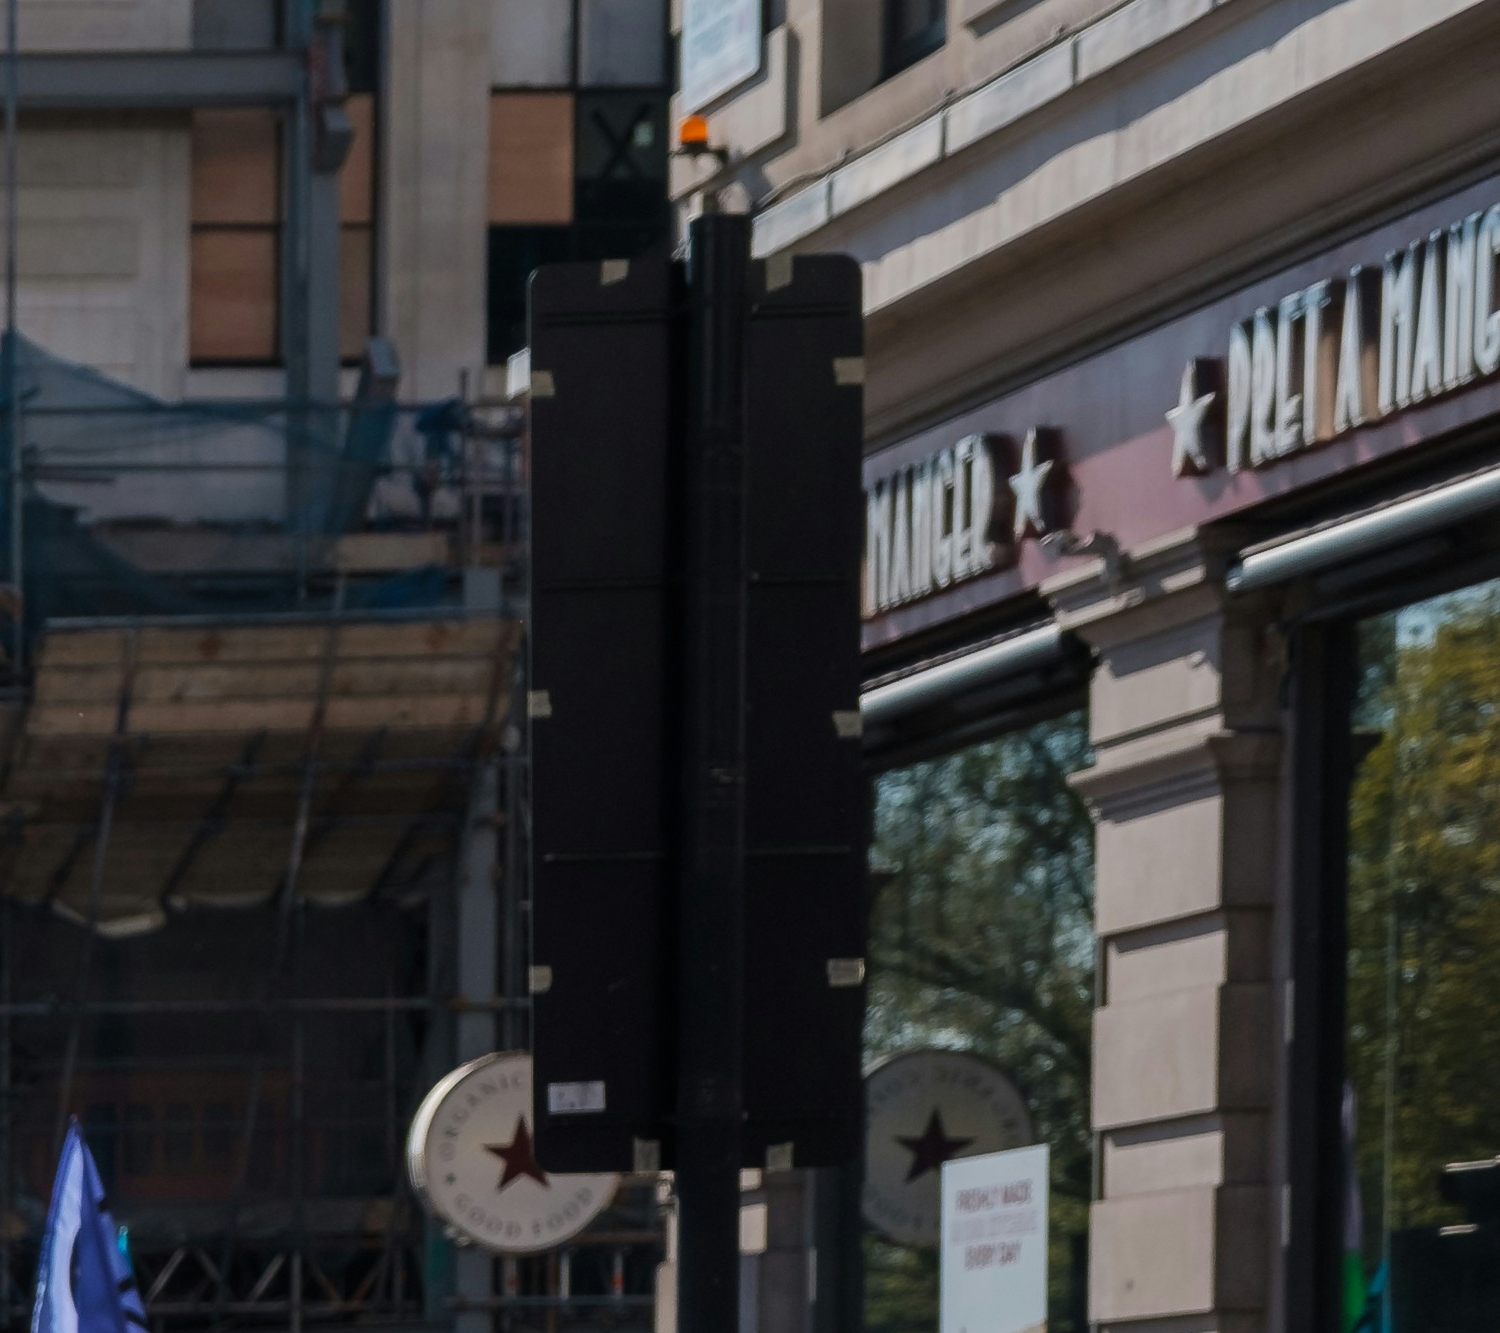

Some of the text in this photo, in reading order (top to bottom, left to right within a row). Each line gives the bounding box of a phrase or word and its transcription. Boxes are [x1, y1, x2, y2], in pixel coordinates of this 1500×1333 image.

[1227, 206, 1500, 474] PRET A MANG
[438, 1074, 522, 1162] ORGANIC
[454, 1187, 594, 1238] GOOD FOOD
